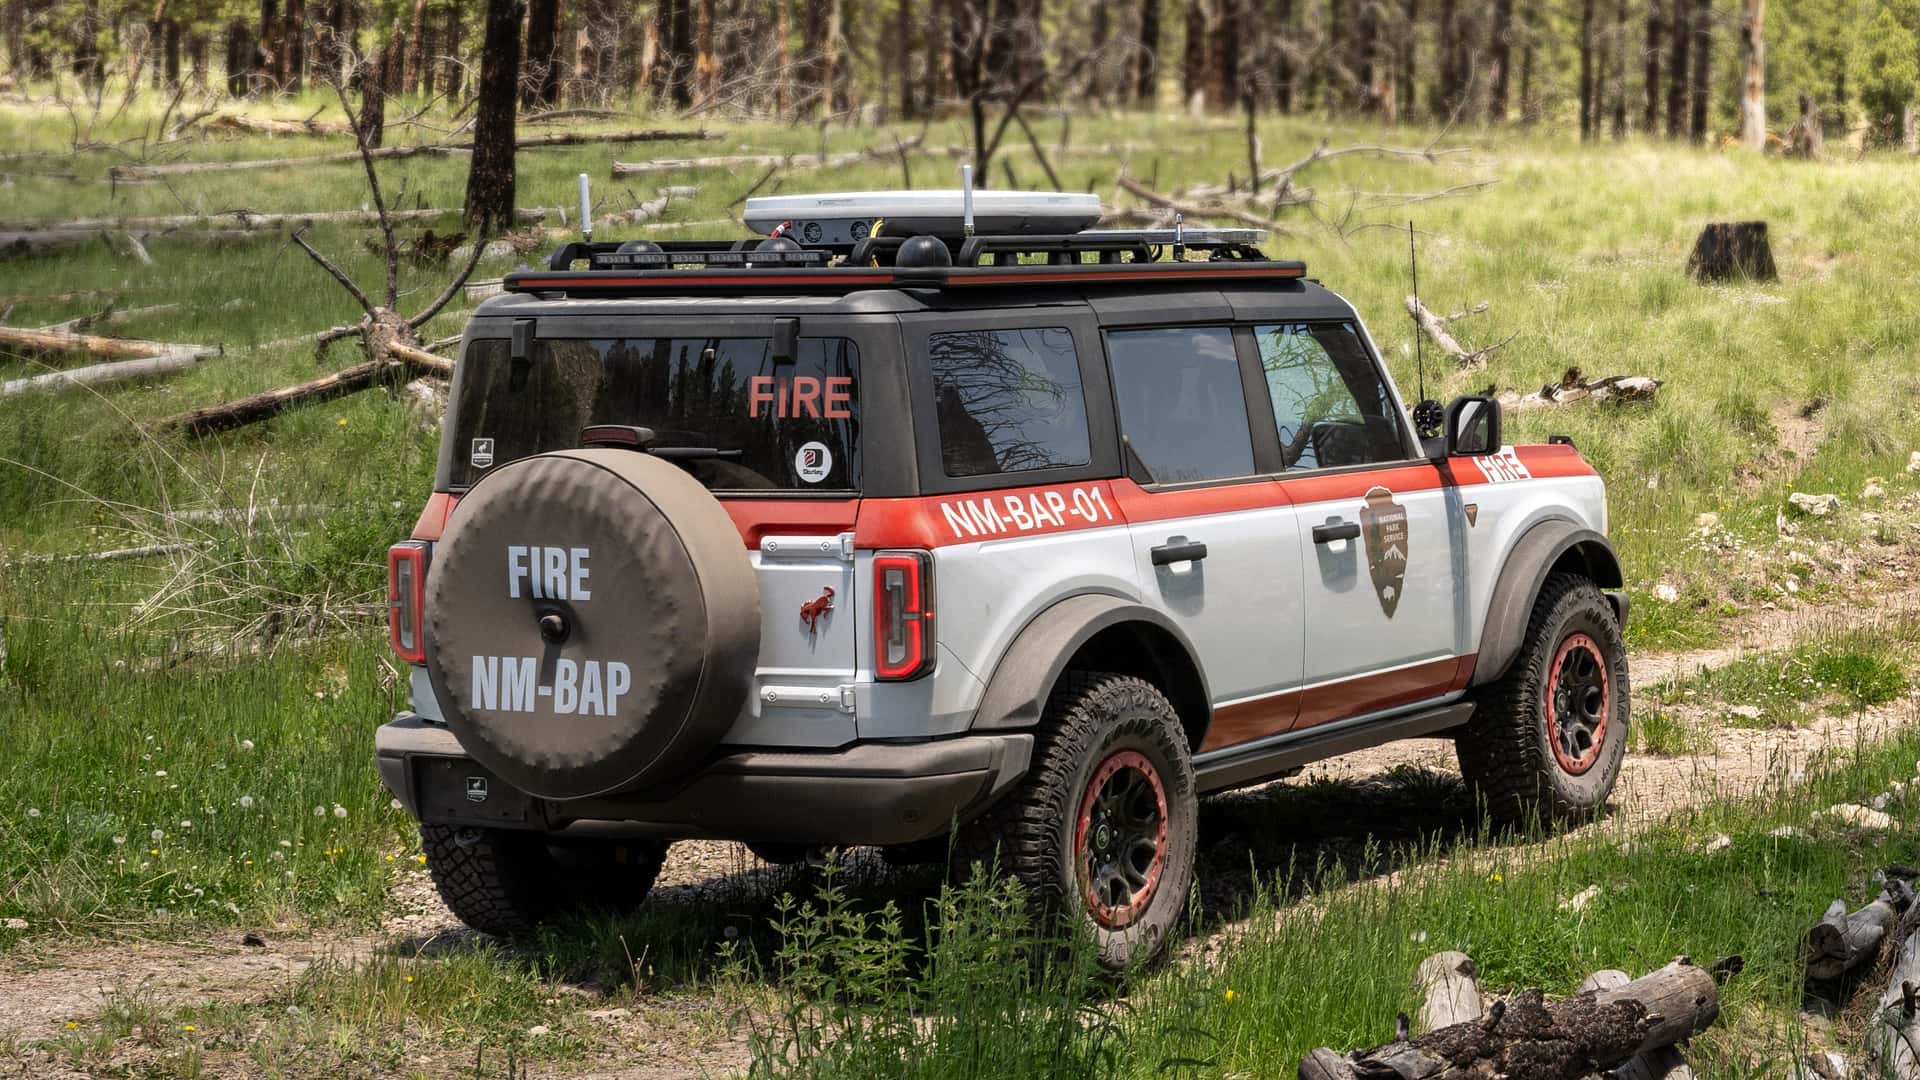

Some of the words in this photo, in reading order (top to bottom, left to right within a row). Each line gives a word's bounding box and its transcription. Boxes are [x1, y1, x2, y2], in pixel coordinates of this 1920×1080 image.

[749, 376, 852, 418] FIRE
[1472, 446, 1532, 484] FIRE
[941, 487, 1113, 538] NM-BAP-01
[1379, 513, 1404, 522] NATIONAL
[1386, 524, 1400, 532] PARK
[1384, 532, 1404, 543] SERVICE
[508, 545, 592, 601] FIRE
[471, 655, 632, 716] NM-BAP
